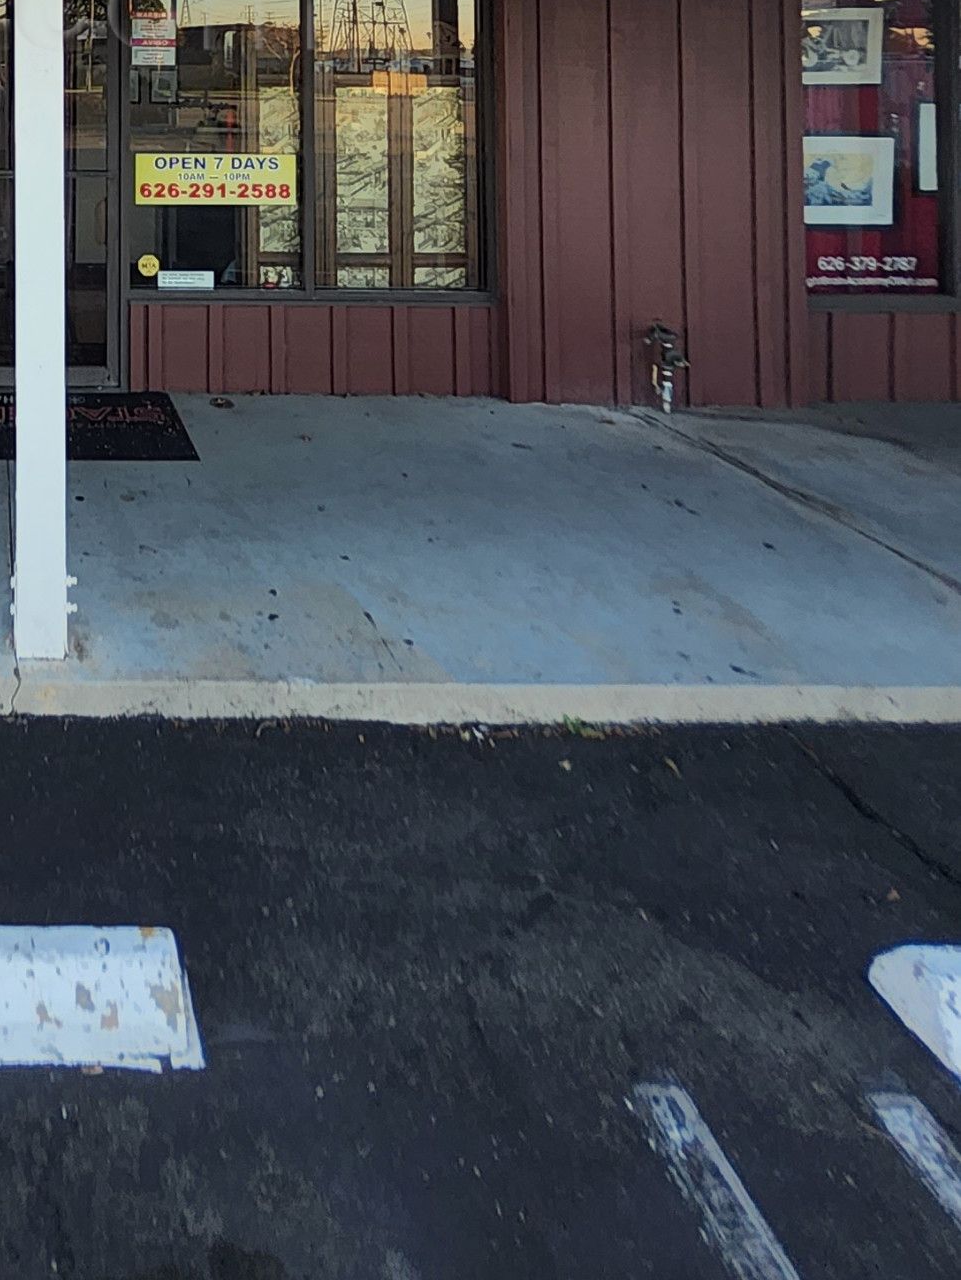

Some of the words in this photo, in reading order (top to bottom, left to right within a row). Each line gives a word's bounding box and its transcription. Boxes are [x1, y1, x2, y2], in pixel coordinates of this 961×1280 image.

[154, 157, 206, 170] OPEN
[213, 157, 224, 169] 7
[231, 157, 279, 170] DAYS
[178, 173, 205, 181] 10AM
[223, 173, 250, 181] 10PM
[139, 183, 291, 199] 626-291-2588
